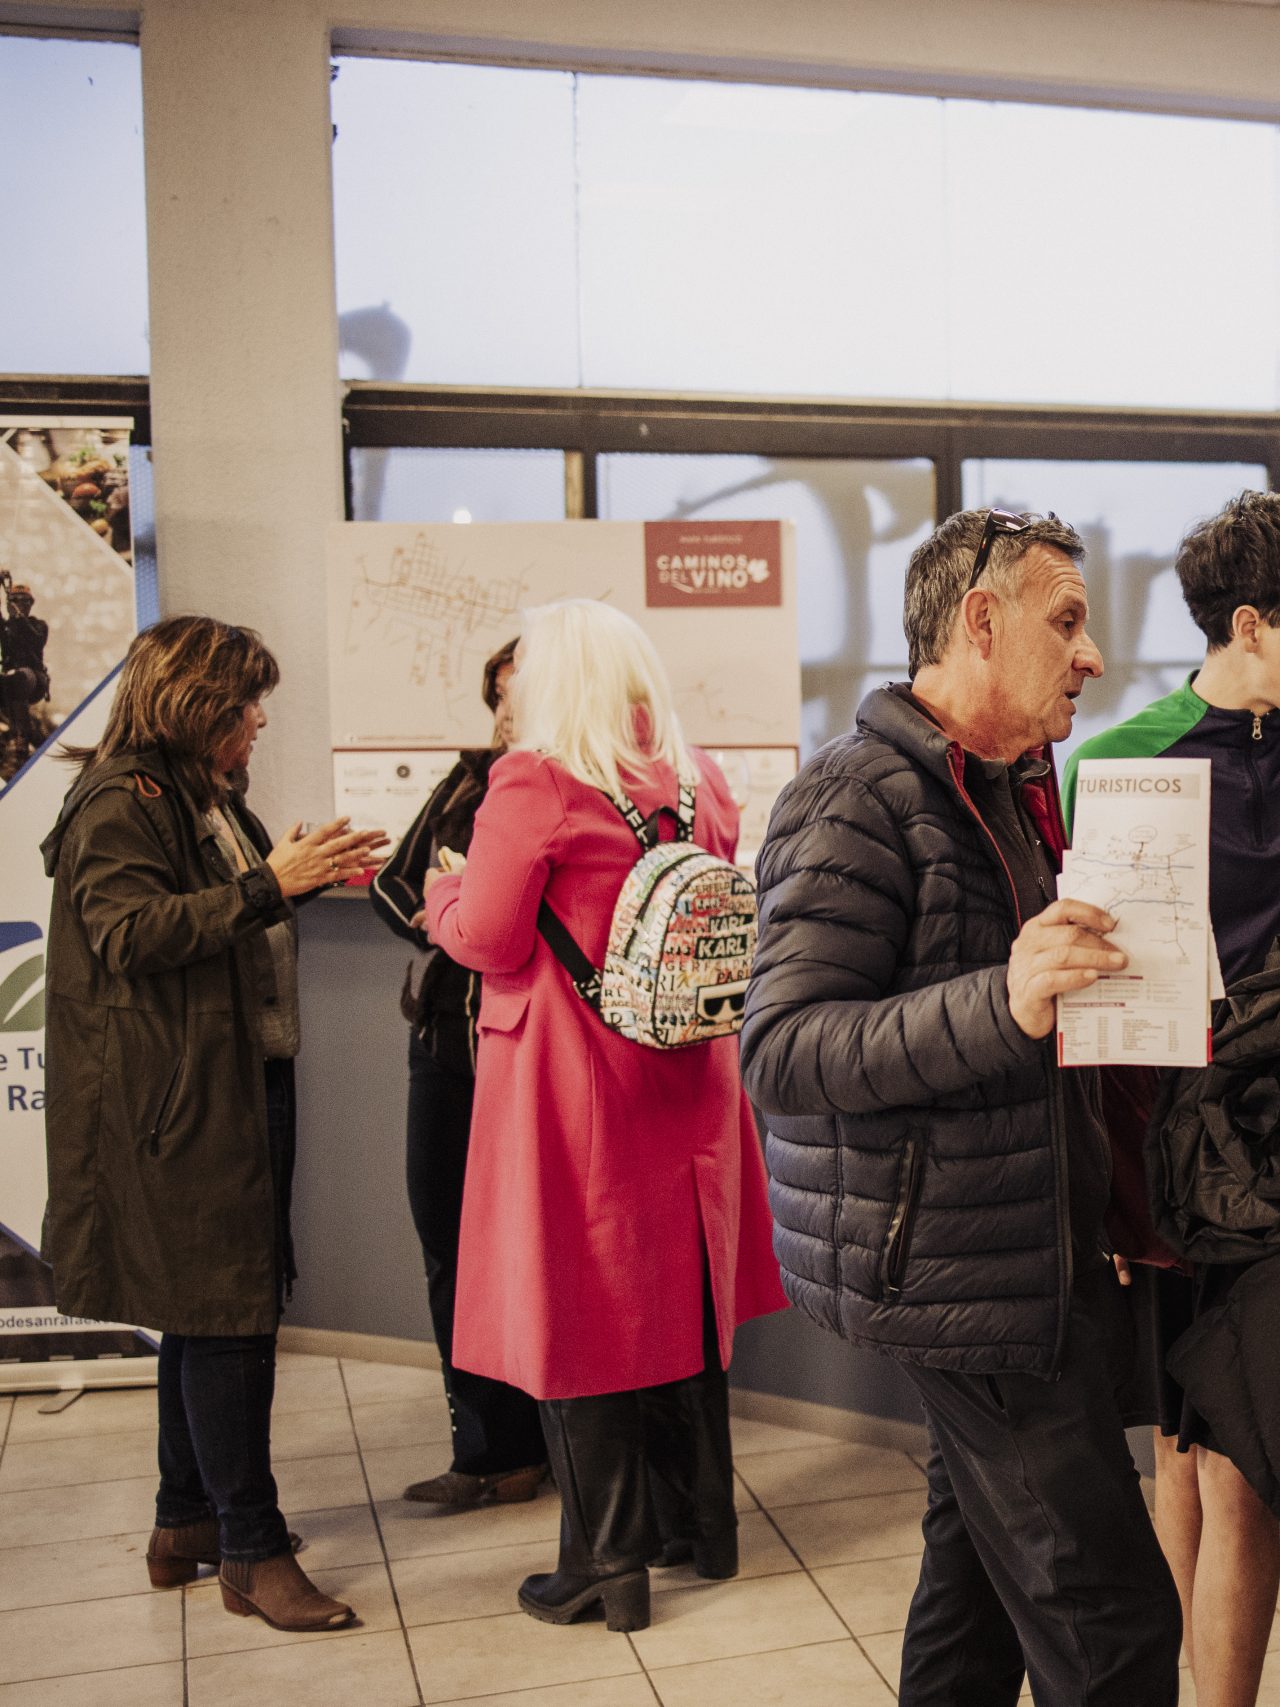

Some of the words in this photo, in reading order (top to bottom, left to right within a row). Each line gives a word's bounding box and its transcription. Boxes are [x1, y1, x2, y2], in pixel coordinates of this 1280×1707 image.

[656, 554, 748, 570] CAMINOS
[690, 569, 749, 589] VINO
[1079, 778, 1182, 794] TURISTICOS
[699, 938, 746, 957] KARL
